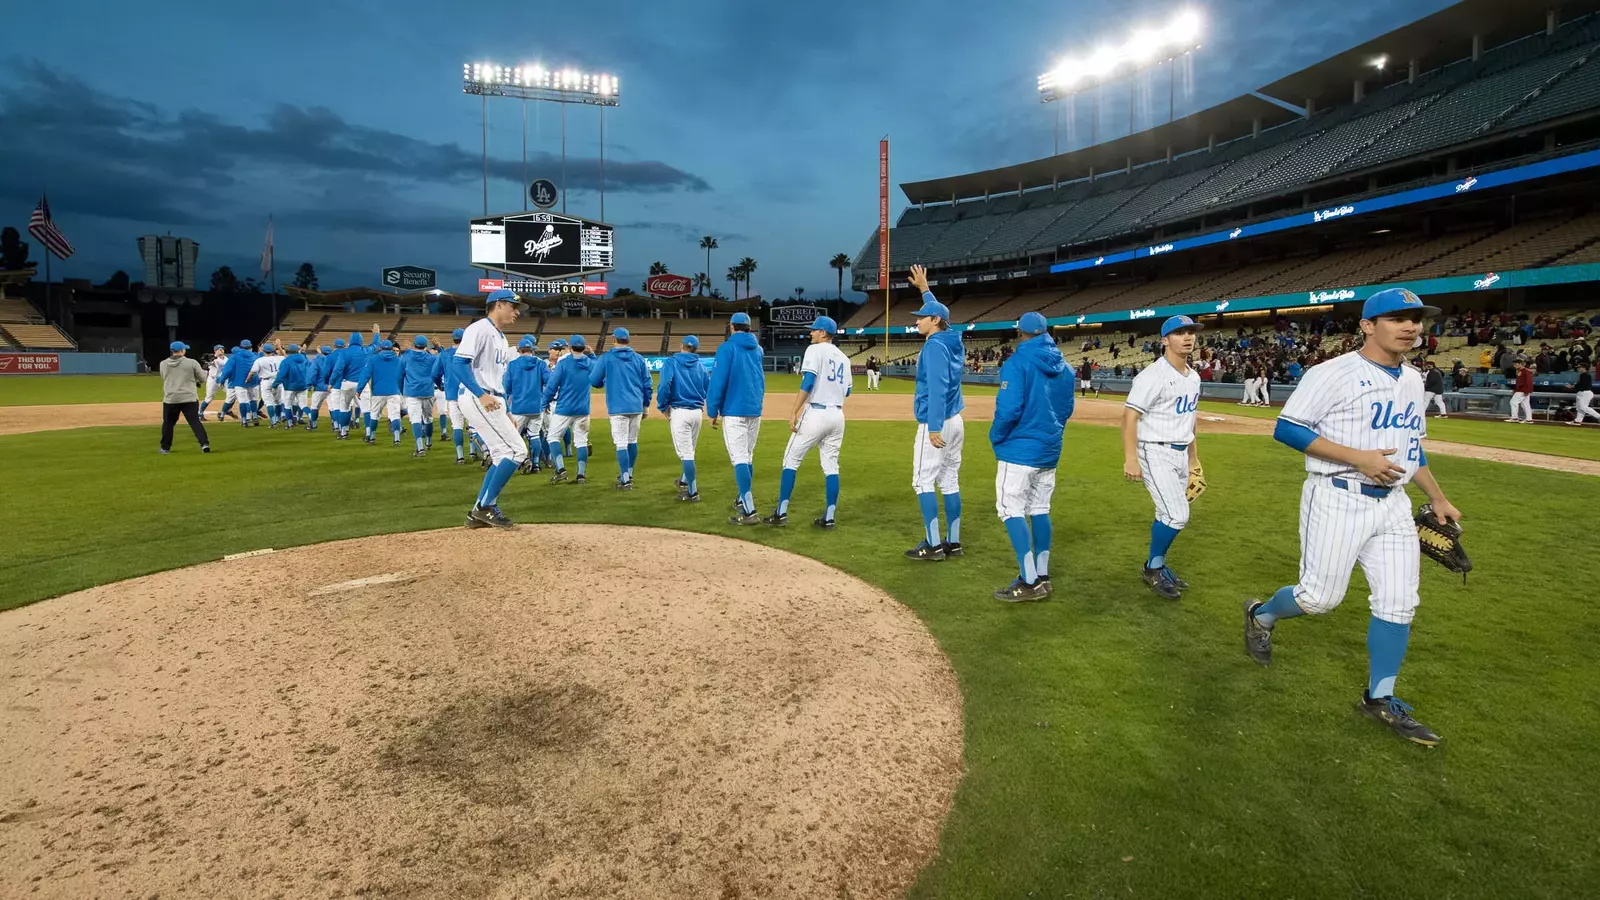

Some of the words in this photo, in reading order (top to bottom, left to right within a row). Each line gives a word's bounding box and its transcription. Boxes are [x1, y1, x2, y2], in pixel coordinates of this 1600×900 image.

[536, 183, 551, 203] LA
[524, 234, 563, 255] Dodgers
[403, 271, 432, 279] Security
[403, 278, 428, 286] Benefit
[269, 362, 278, 373] 11
[827, 359, 844, 384] 34
[1176, 392, 1199, 415] Ucl
[1371, 400, 1421, 431] Ucla
